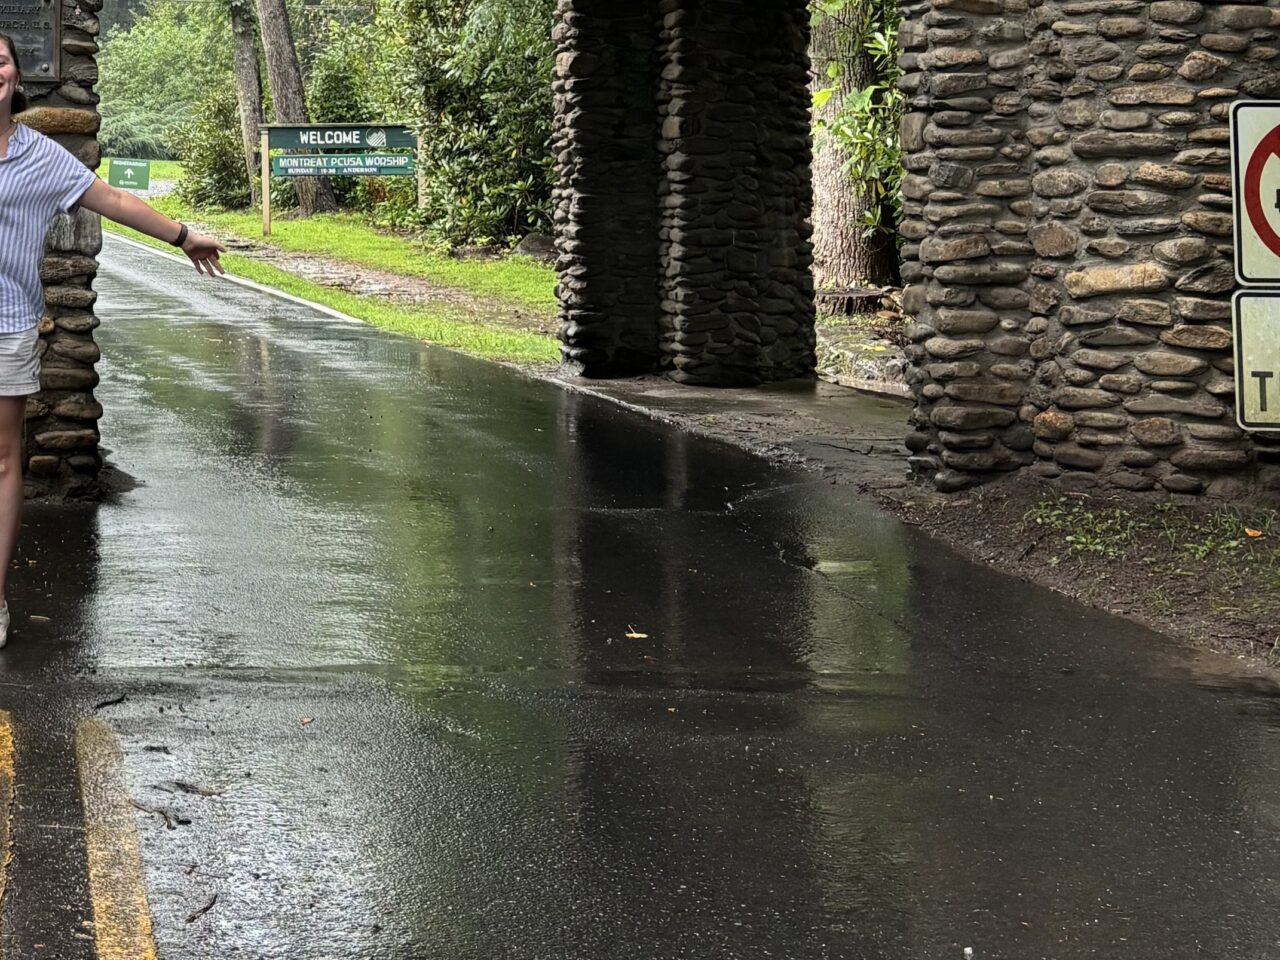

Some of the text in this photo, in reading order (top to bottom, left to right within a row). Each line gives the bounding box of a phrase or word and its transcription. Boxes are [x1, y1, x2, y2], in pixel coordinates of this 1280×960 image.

[299, 131, 360, 144] WELCOME
[279, 156, 409, 168] MONTREAT PCUSA WORSHIP
[1251, 370, 1280, 412] T
